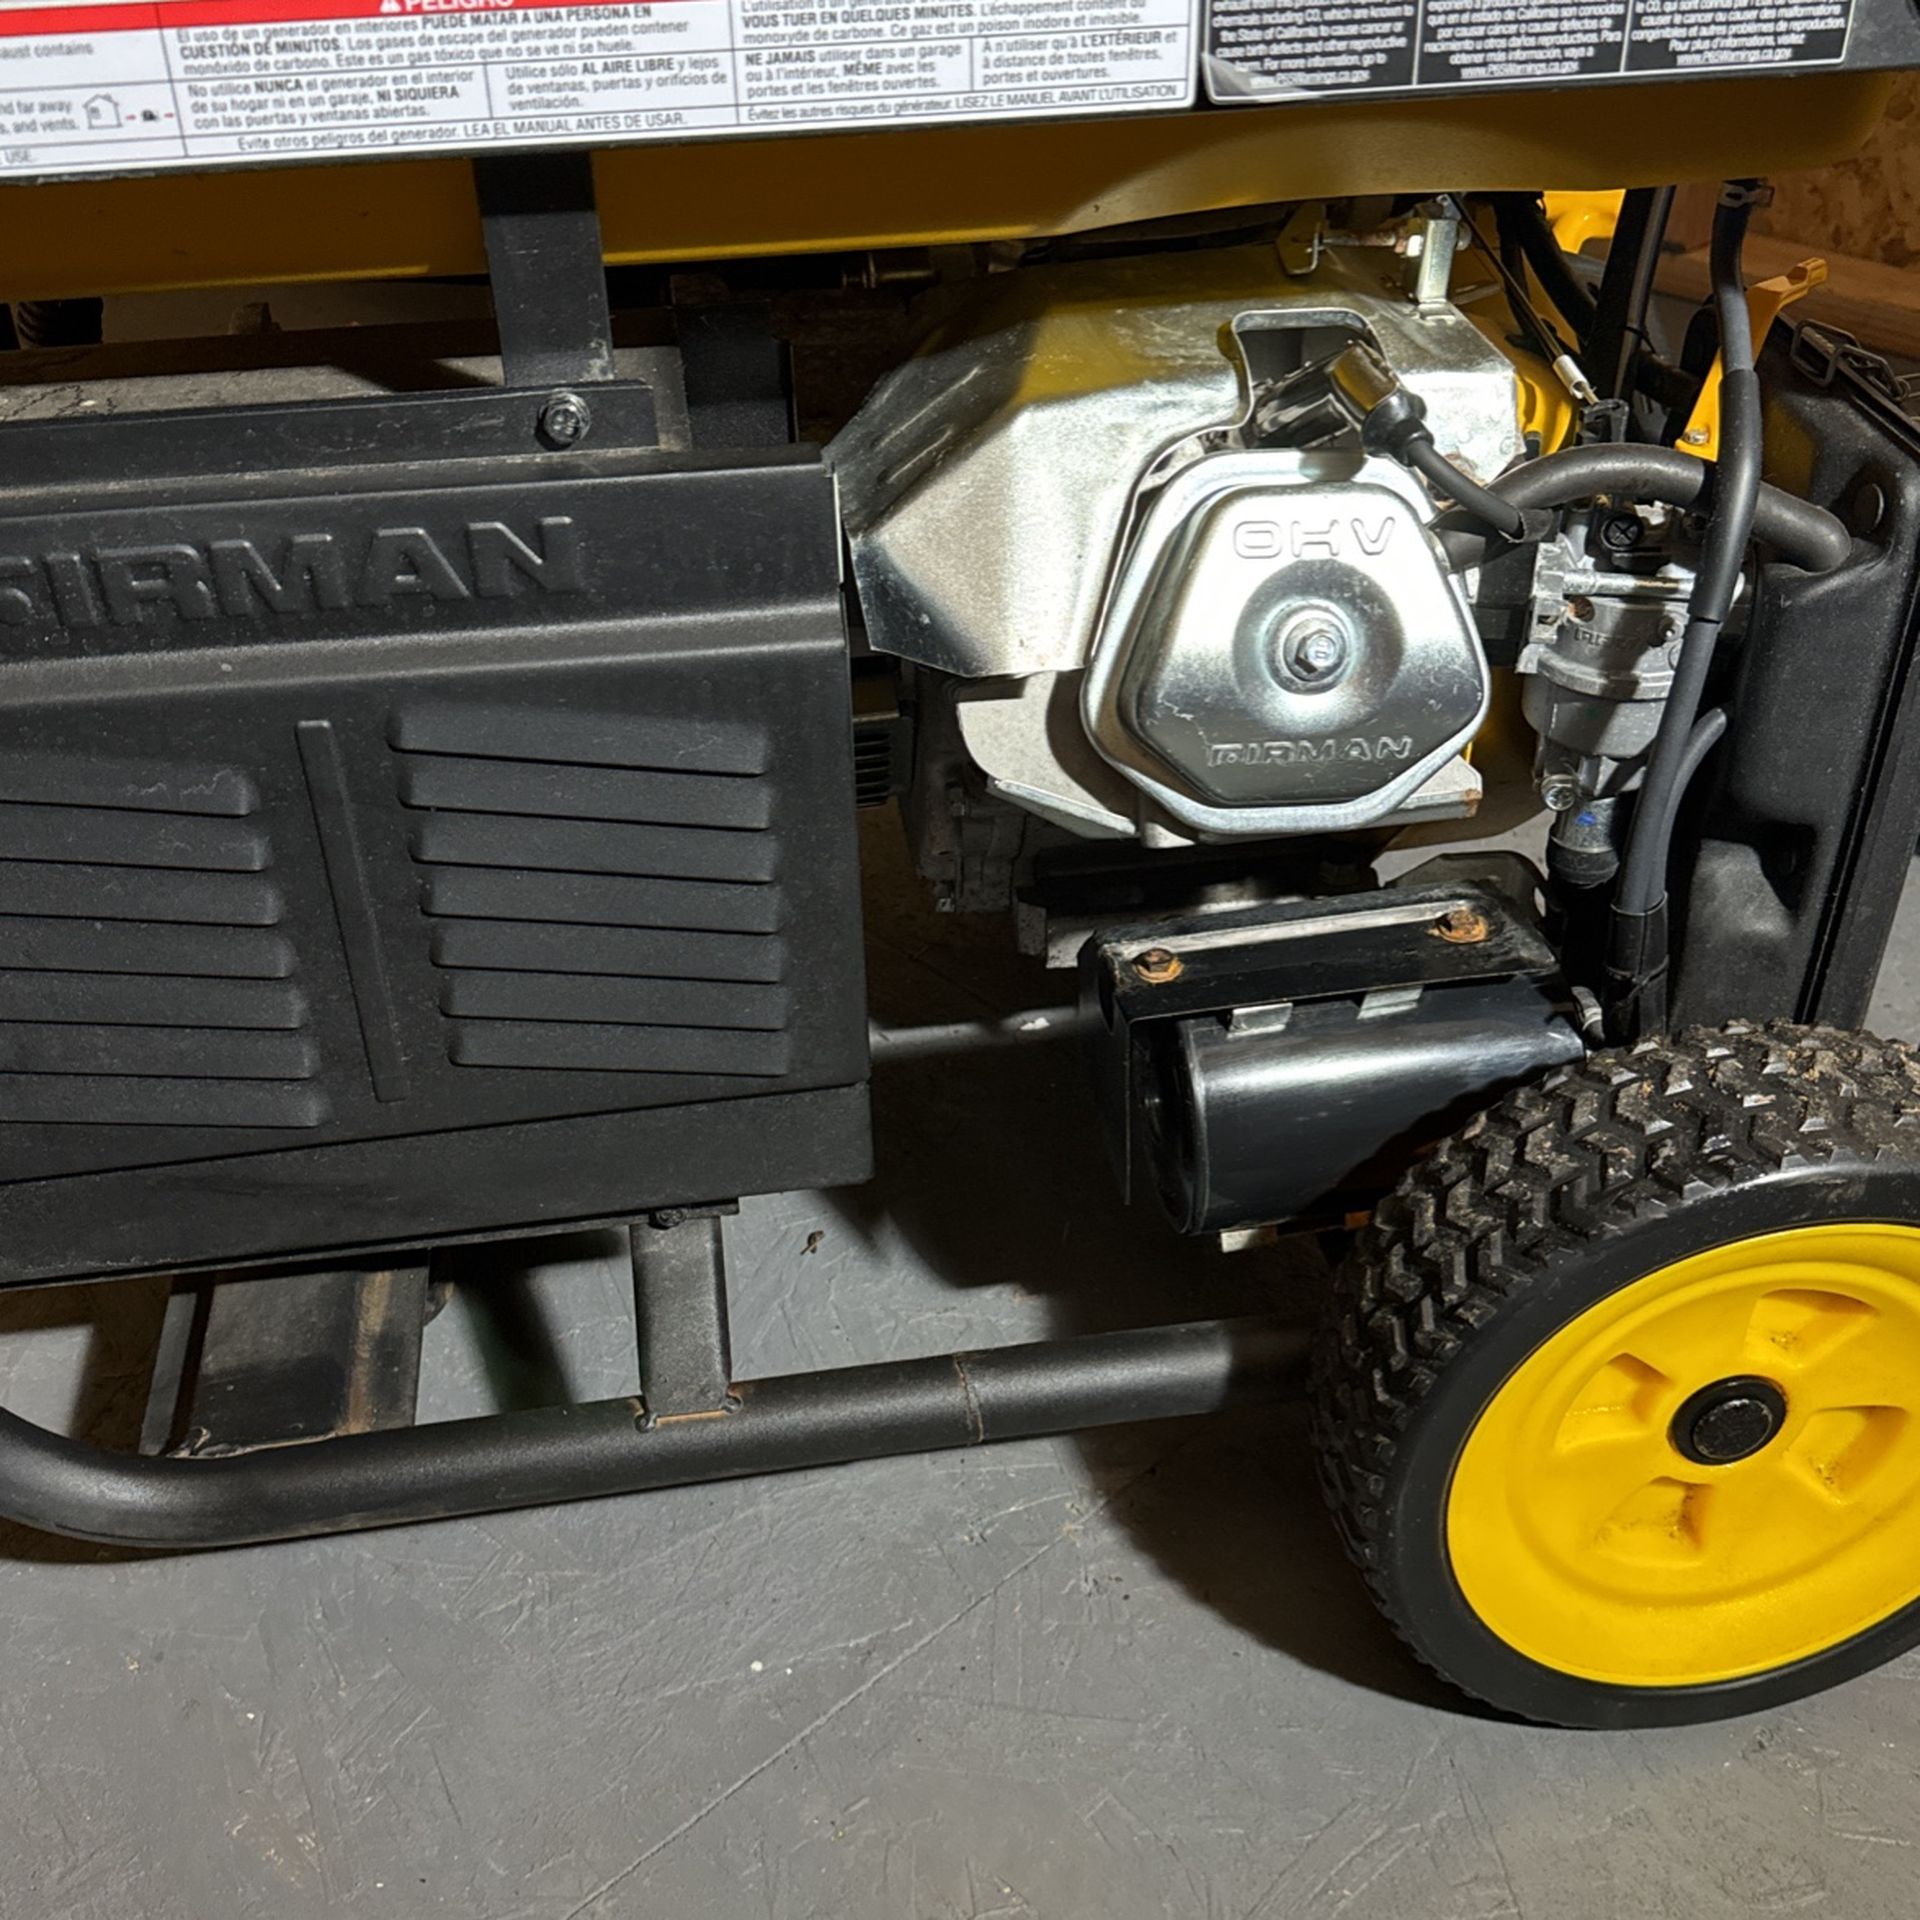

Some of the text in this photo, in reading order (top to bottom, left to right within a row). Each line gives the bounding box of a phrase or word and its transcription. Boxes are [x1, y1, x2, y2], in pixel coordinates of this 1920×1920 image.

[193, 30, 218, 42] uso
[262, 25, 330, 39] generador
[354, 20, 418, 33] interiores
[421, 14, 466, 29] PUEDE
[469, 11, 518, 25] MATAR
[534, 10, 562, 23] UNA
[566, 5, 630, 21] PERSONA
[743, 14, 778, 28] VOUS
[783, 12, 816, 26] TUER
[841, 7, 910, 24] QUELQUES
[981, 0, 1072, 17] L'échappement
[179, 42, 251, 59] CUESTIÓN
[347, 37, 373, 50] Los
[375, 37, 415, 50] gases
[437, 33, 484, 47] escape
[486, 29, 507, 42] del
[510, 27, 576, 43] generador
[580, 24, 628, 39] pueden
[631, 21, 689, 34] contener
[744, 31, 810, 45] monoxyde
[911, 24, 931, 38] gaz
[936, 22, 954, 34] est
[978, 20, 1019, 33] poison
[1023, 17, 1070, 29] inodore
[995, 38, 1047, 52] n'utiliser
[1052, 36, 1077, 50] qu'à
[1081, 31, 1161, 47] L'EXTÉRIEUR
[182, 61, 250, 75] monóxido
[335, 52, 365, 67] Este
[407, 51, 431, 66] gas
[434, 48, 475, 61] tóxico
[478, 48, 503, 62] que
[766, 50, 815, 64] JAMAIS
[819, 49, 860, 62] utiliser
[866, 47, 895, 59] dans
[919, 44, 961, 58] garage
[993, 54, 1046, 68] distance
[1067, 51, 1105, 63] toutes
[504, 65, 547, 79] Utilice
[550, 63, 577, 77] sólo
[601, 60, 632, 73] AIRE
[635, 58, 674, 71] LIBRE
[688, 57, 719, 71] lejos
[842, 61, 882, 76] MÊME
[885, 63, 913, 74] avec
[917, 61, 936, 72] les
[983, 72, 1023, 85] portes
[209, 82, 251, 96] utilice
[253, 79, 303, 93] NUNCA
[321, 76, 388, 90] generador
[426, 70, 474, 83] interior
[592, 77, 642, 91] puertas
[654, 72, 708, 87] orificios
[747, 85, 788, 97] portes
[806, 82, 824, 94] les
[827, 79, 878, 92] fenêtres
[230, 98, 269, 112] hogar
[394, 85, 460, 102] SIQUIERA
[193, 117, 220, 129] con
[221, 115, 242, 127] las
[245, 113, 296, 126] puertas
[310, 109, 369, 122] ventanas
[237, 135, 270, 150] Evite
[273, 136, 308, 148] otros
[311, 132, 365, 148] peligros
[367, 130, 387, 142] del
[463, 123, 490, 137] LEA
[513, 119, 571, 133] MANUAL
[575, 115, 620, 130] ANTES
[1233, 516, 1396, 559] OHV
